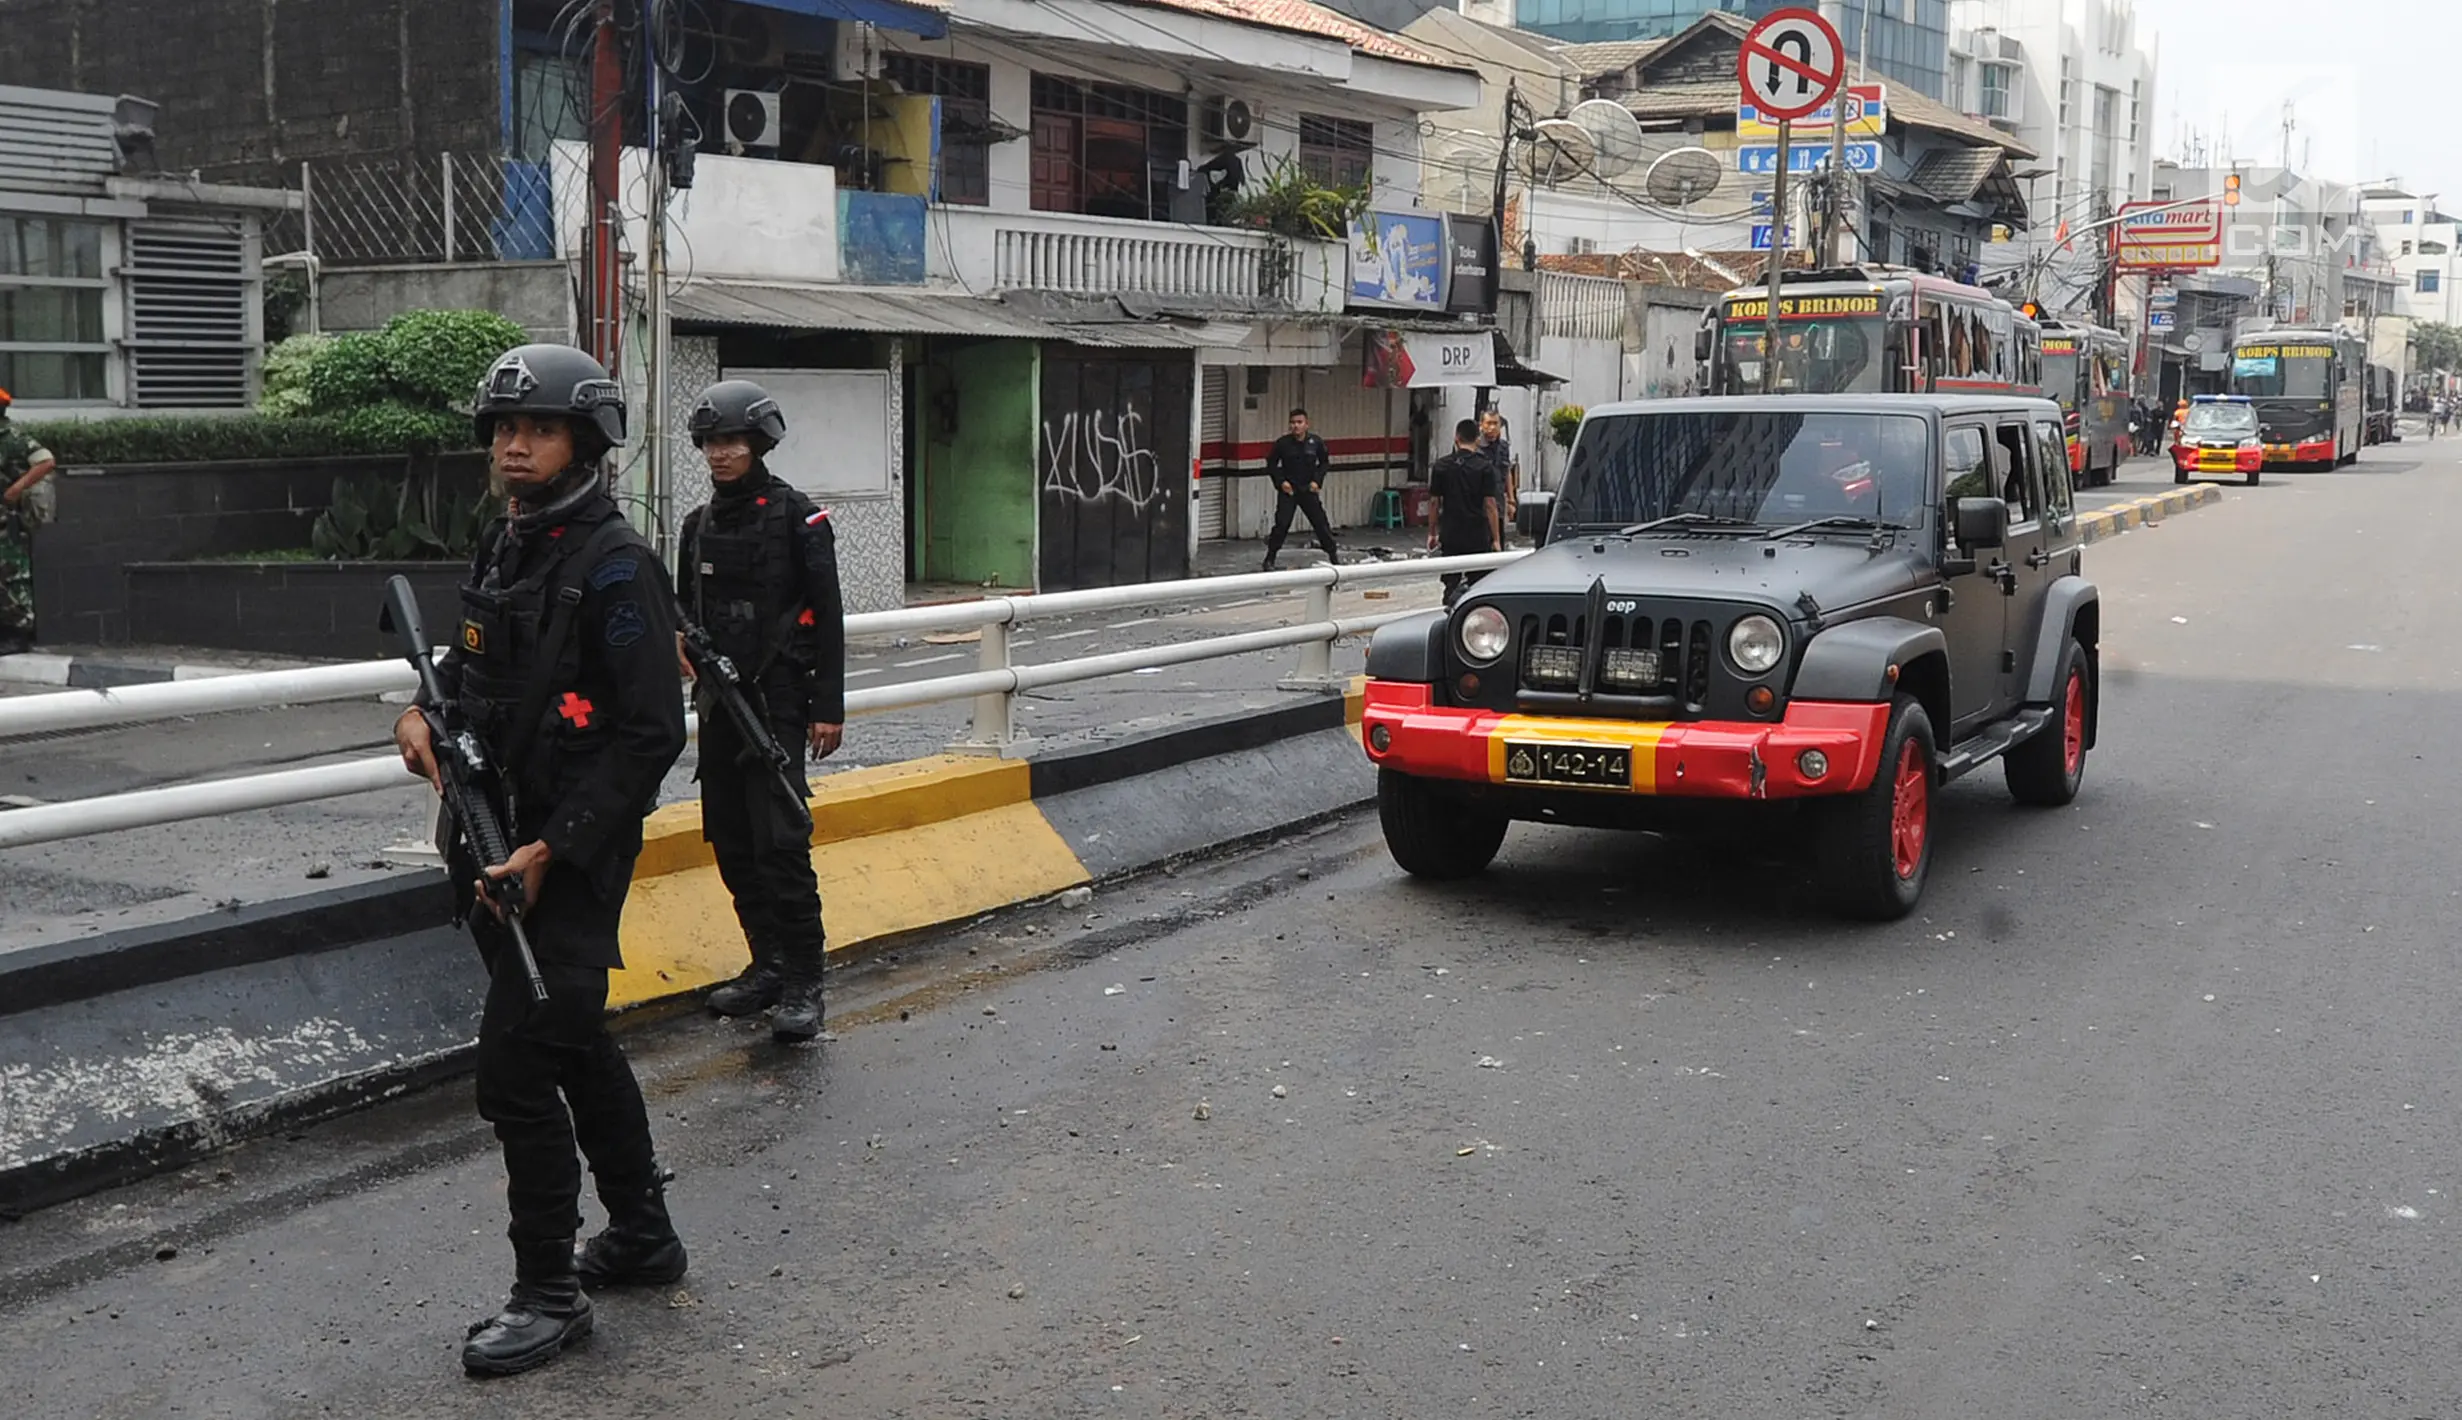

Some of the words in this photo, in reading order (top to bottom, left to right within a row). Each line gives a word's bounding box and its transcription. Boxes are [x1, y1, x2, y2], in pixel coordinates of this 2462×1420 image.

[1732, 300, 1793, 317] KORS
[1800, 298, 1878, 314] BRIMOB
[1442, 347, 1471, 366] DRP
[2238, 346, 2279, 359] KORPS
[2281, 346, 2332, 358] BRIMOB
[1606, 600, 1637, 614] eep
[1543, 751, 1625, 777] 142-14
